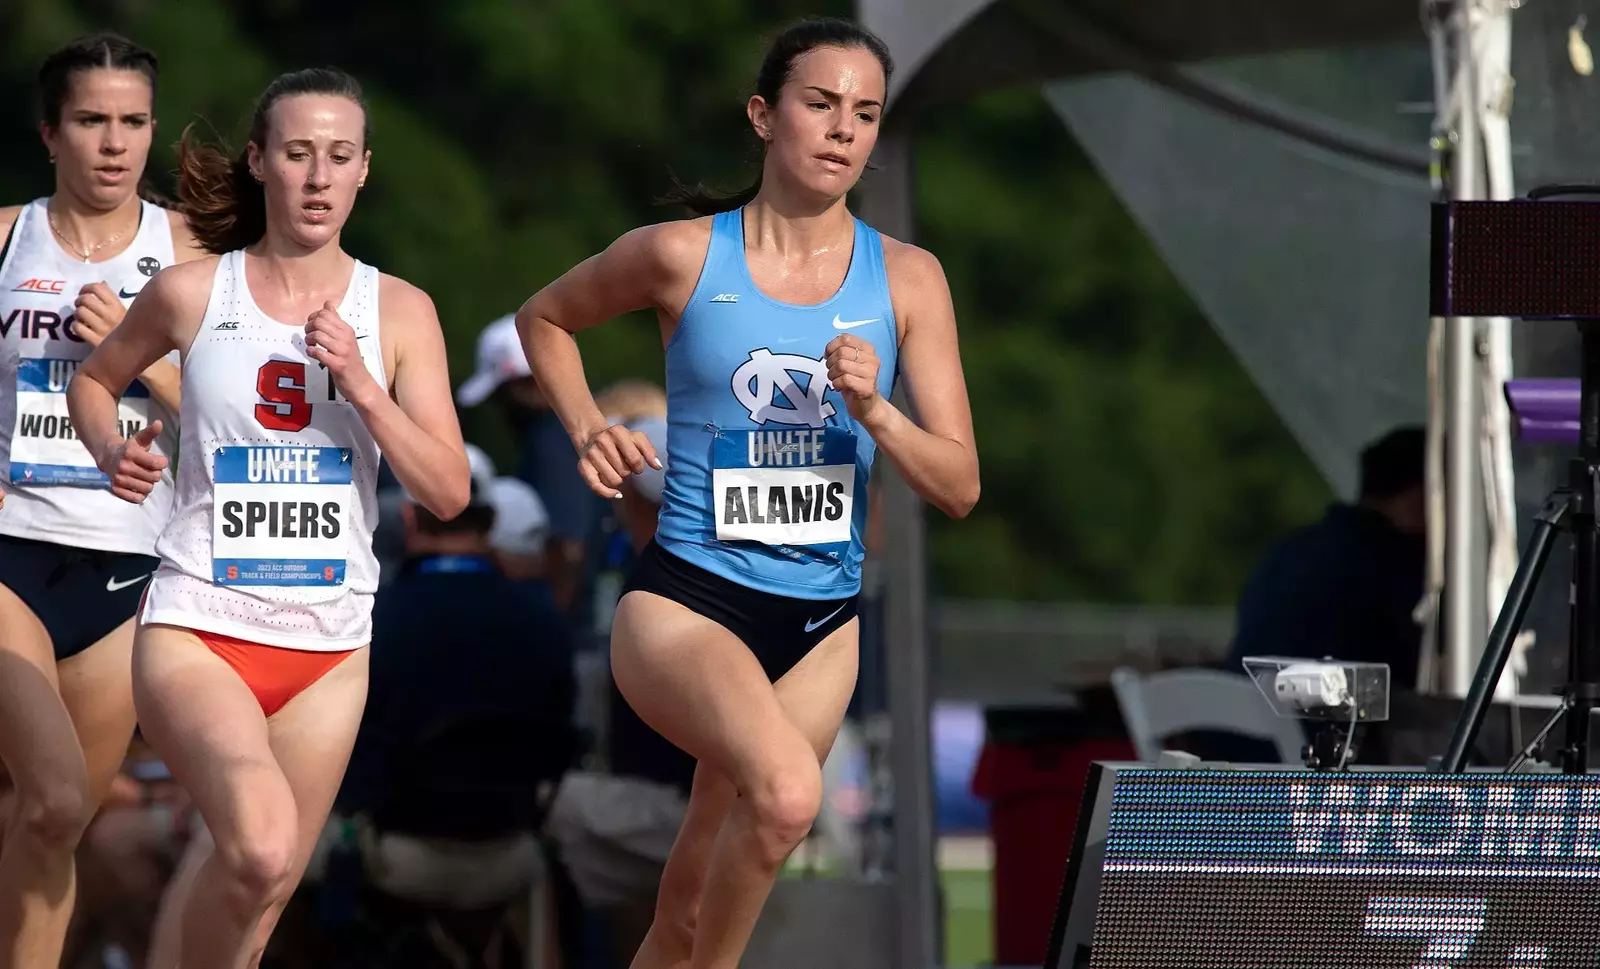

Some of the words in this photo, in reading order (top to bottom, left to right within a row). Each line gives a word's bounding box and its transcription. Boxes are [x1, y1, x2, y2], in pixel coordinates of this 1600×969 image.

[16, 278, 66, 292] ACC
[710, 293, 741, 302] ACC
[214, 321, 240, 329] ACC
[254, 359, 313, 433] S
[20, 413, 141, 441] WORAN
[747, 429, 826, 467] UNITE
[247, 447, 321, 483] UNITE
[723, 481, 844, 526] ALANIS
[222, 500, 341, 540] SPIERS
[265, 572, 280, 580] FIELD
[272, 564, 282, 572] ACC
